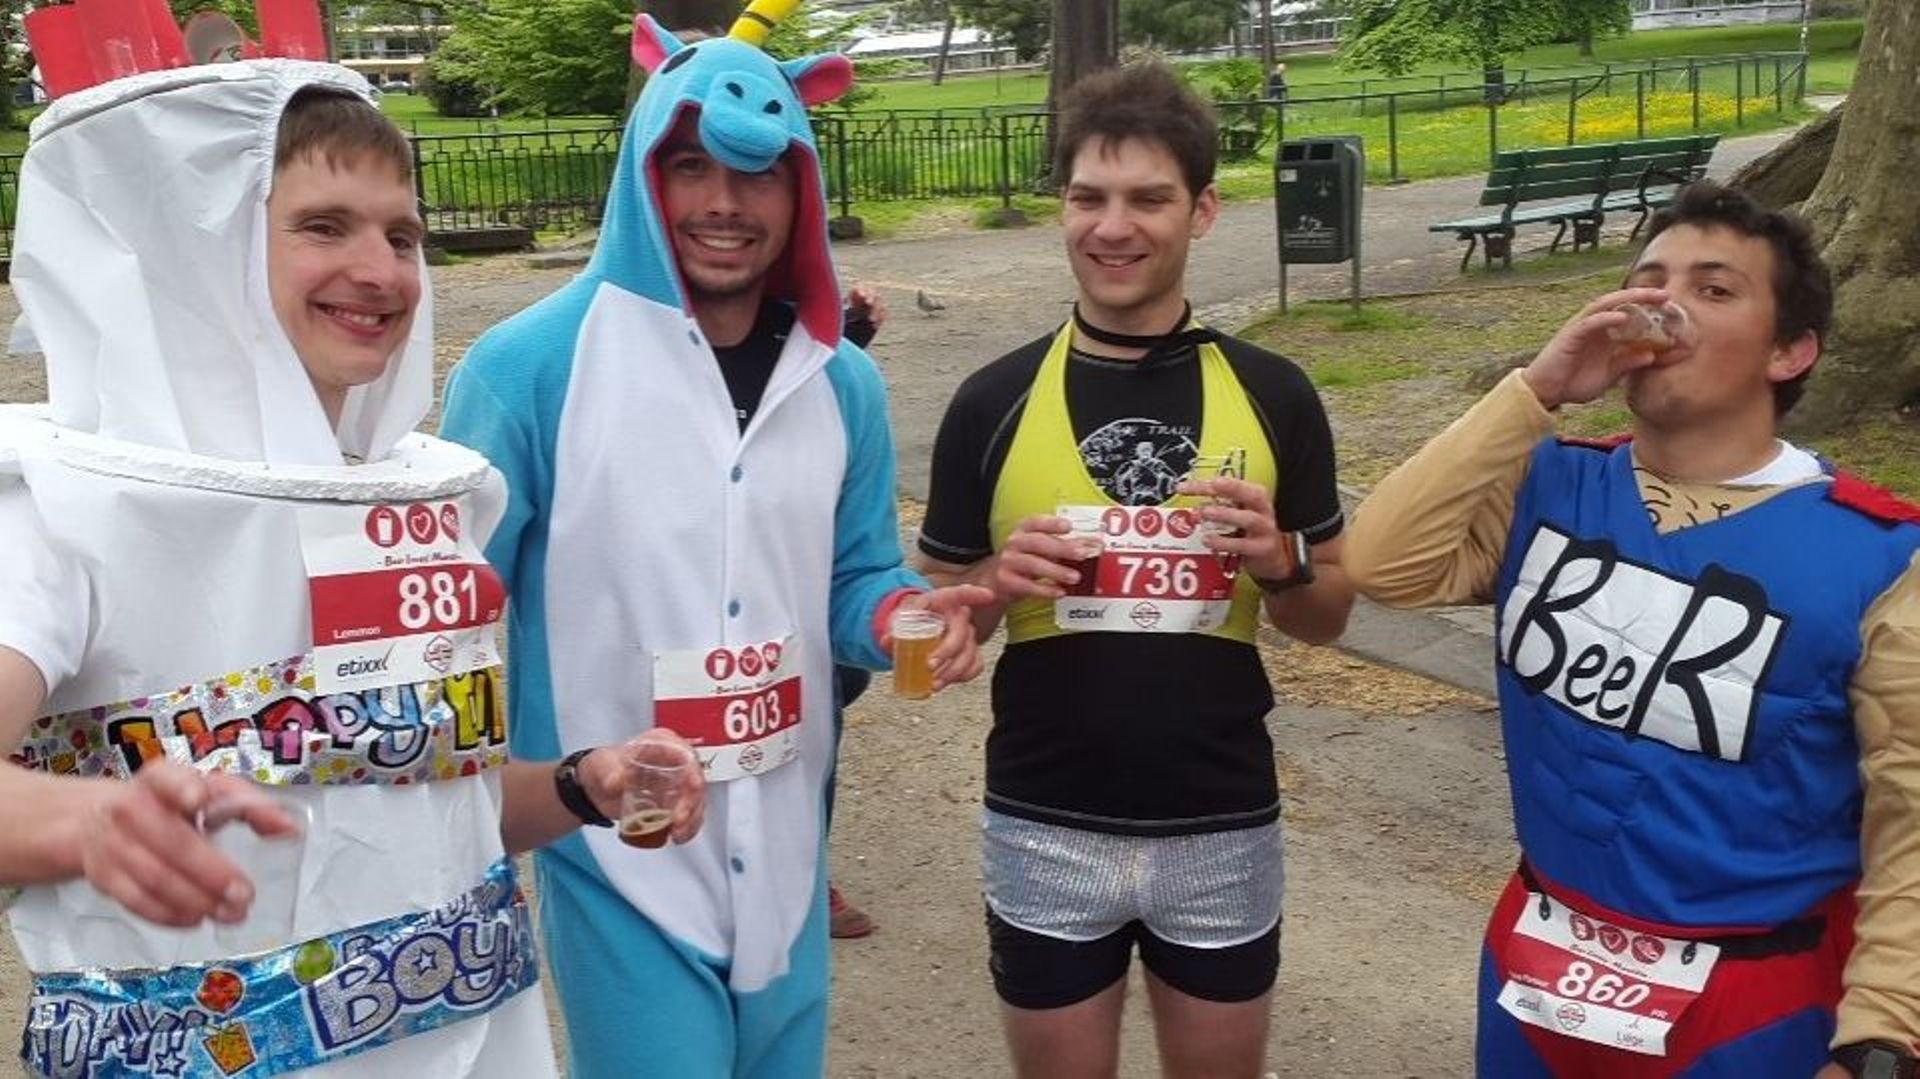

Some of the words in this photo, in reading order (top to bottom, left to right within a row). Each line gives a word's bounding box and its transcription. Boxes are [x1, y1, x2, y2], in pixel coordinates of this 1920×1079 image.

[399, 569, 478, 629] 881
[1117, 557, 1199, 597] 736
[724, 689, 781, 740] 603
[1556, 961, 1650, 1008] 860
